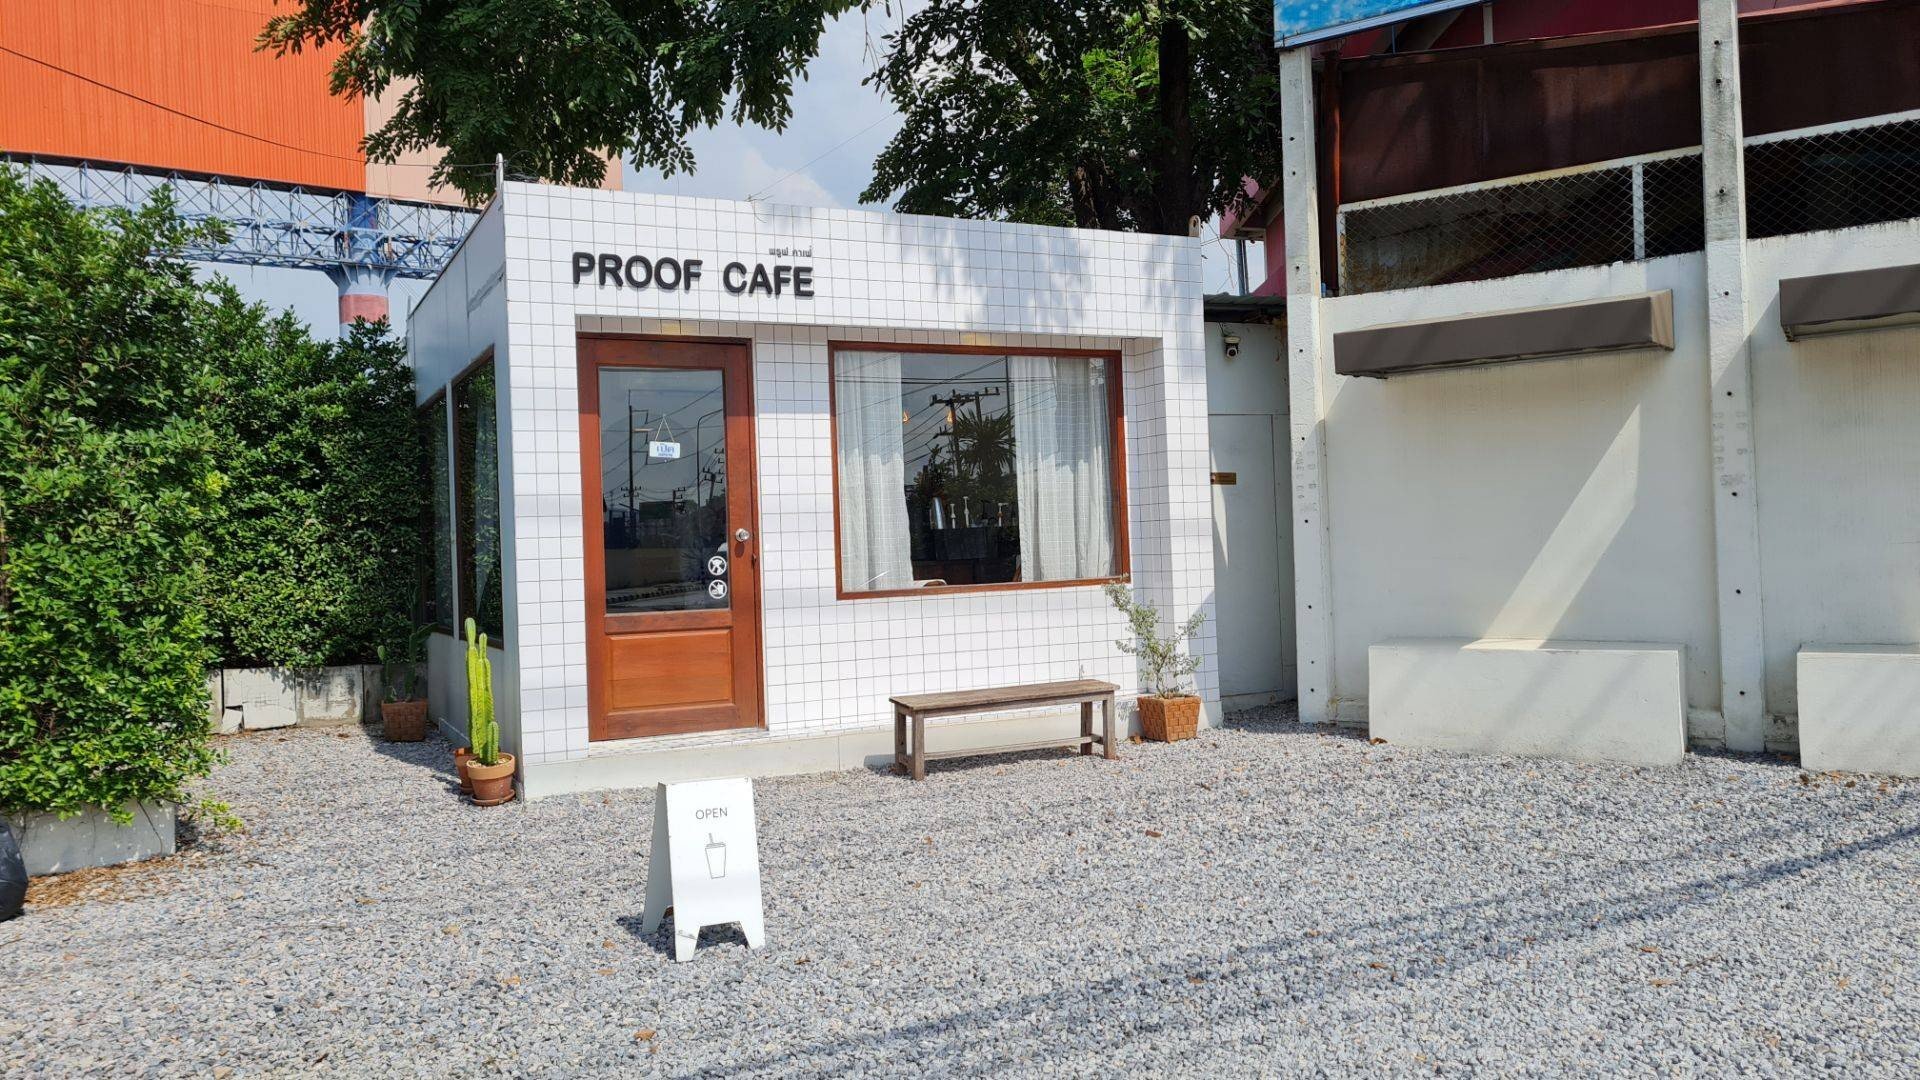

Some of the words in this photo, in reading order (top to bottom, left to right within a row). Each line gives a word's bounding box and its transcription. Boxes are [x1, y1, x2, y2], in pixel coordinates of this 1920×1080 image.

[572, 251, 703, 291] PROOF
[723, 261, 815, 298] CAFE
[695, 807, 728, 820] OPEN
